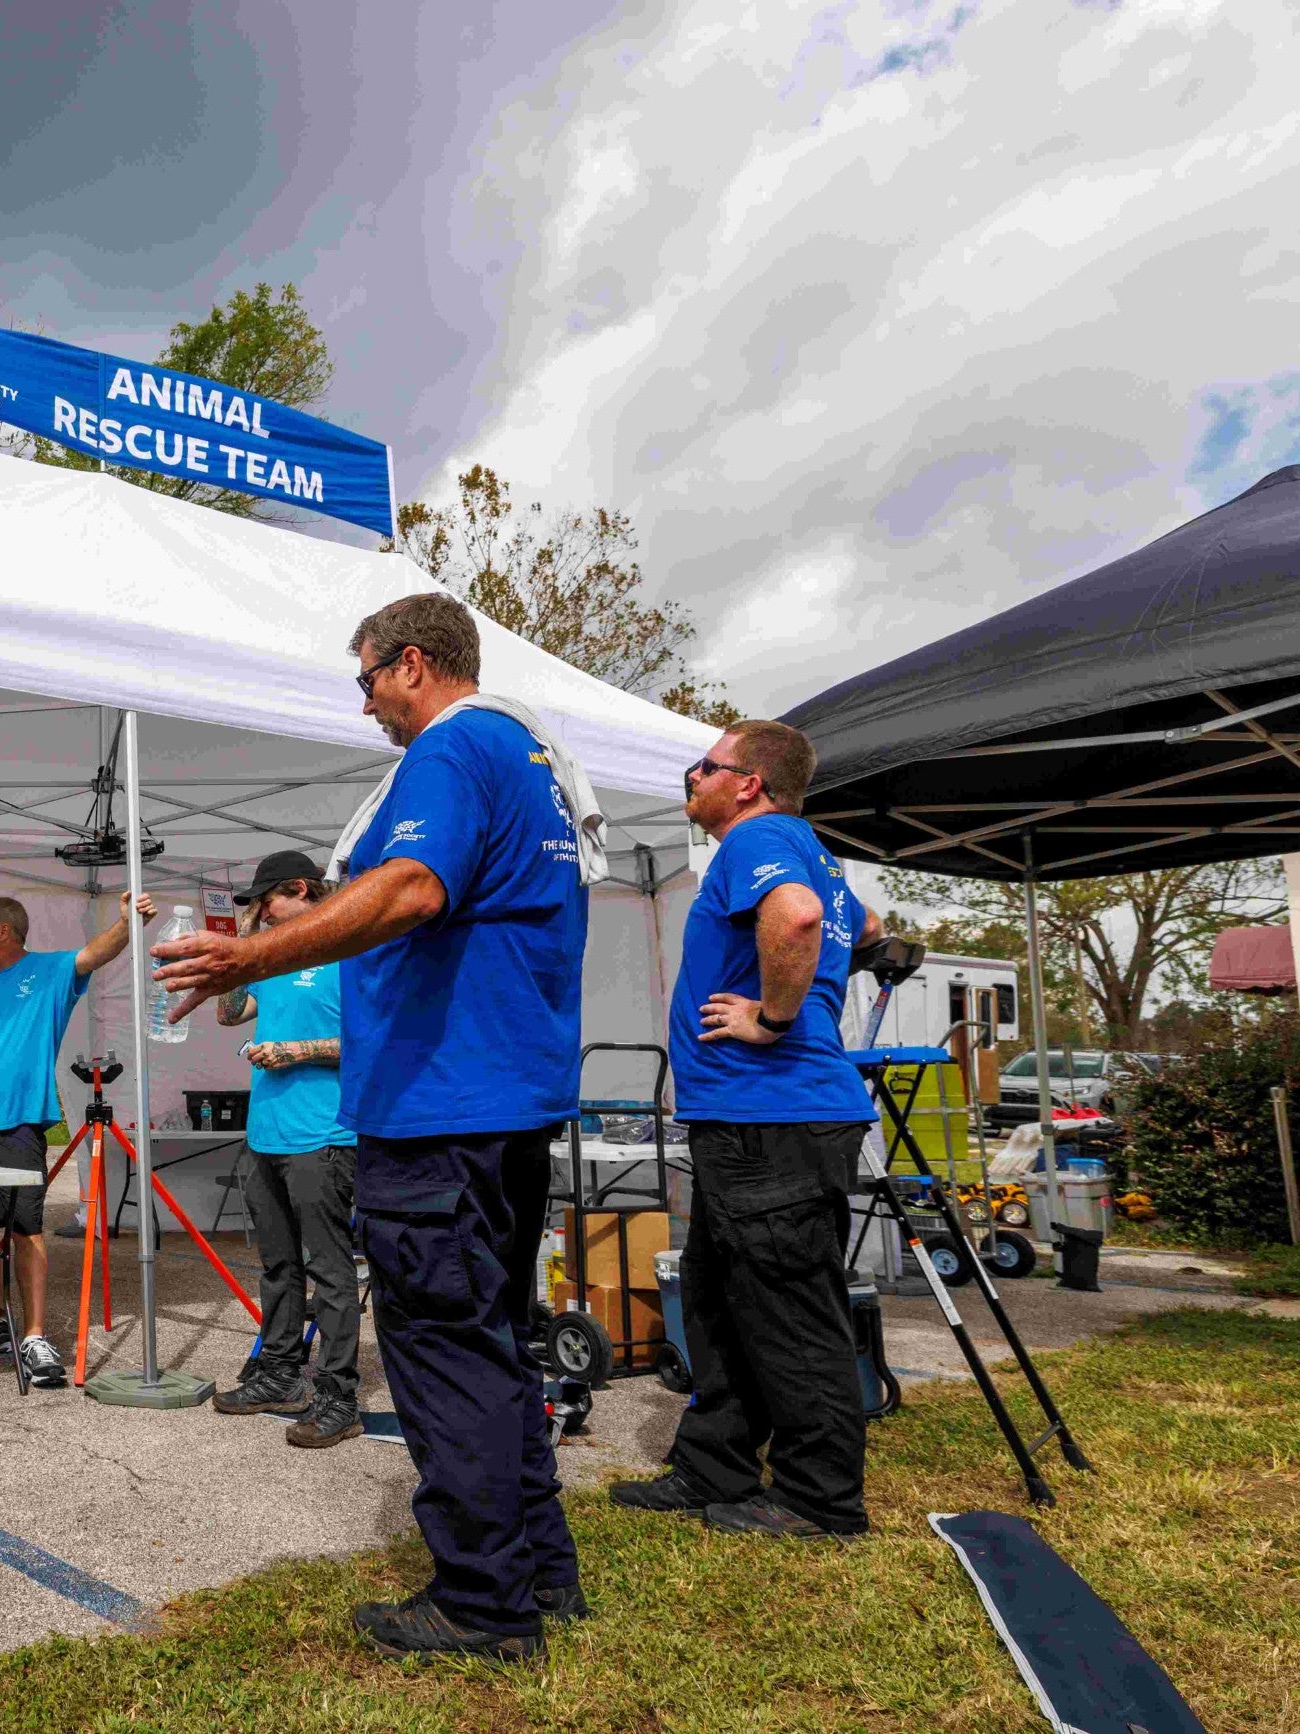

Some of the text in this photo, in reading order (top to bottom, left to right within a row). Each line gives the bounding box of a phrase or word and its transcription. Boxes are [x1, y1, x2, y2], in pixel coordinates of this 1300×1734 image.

[107, 367, 270, 439] ANIMAL
[53, 395, 324, 503] RESCUE TEAM
